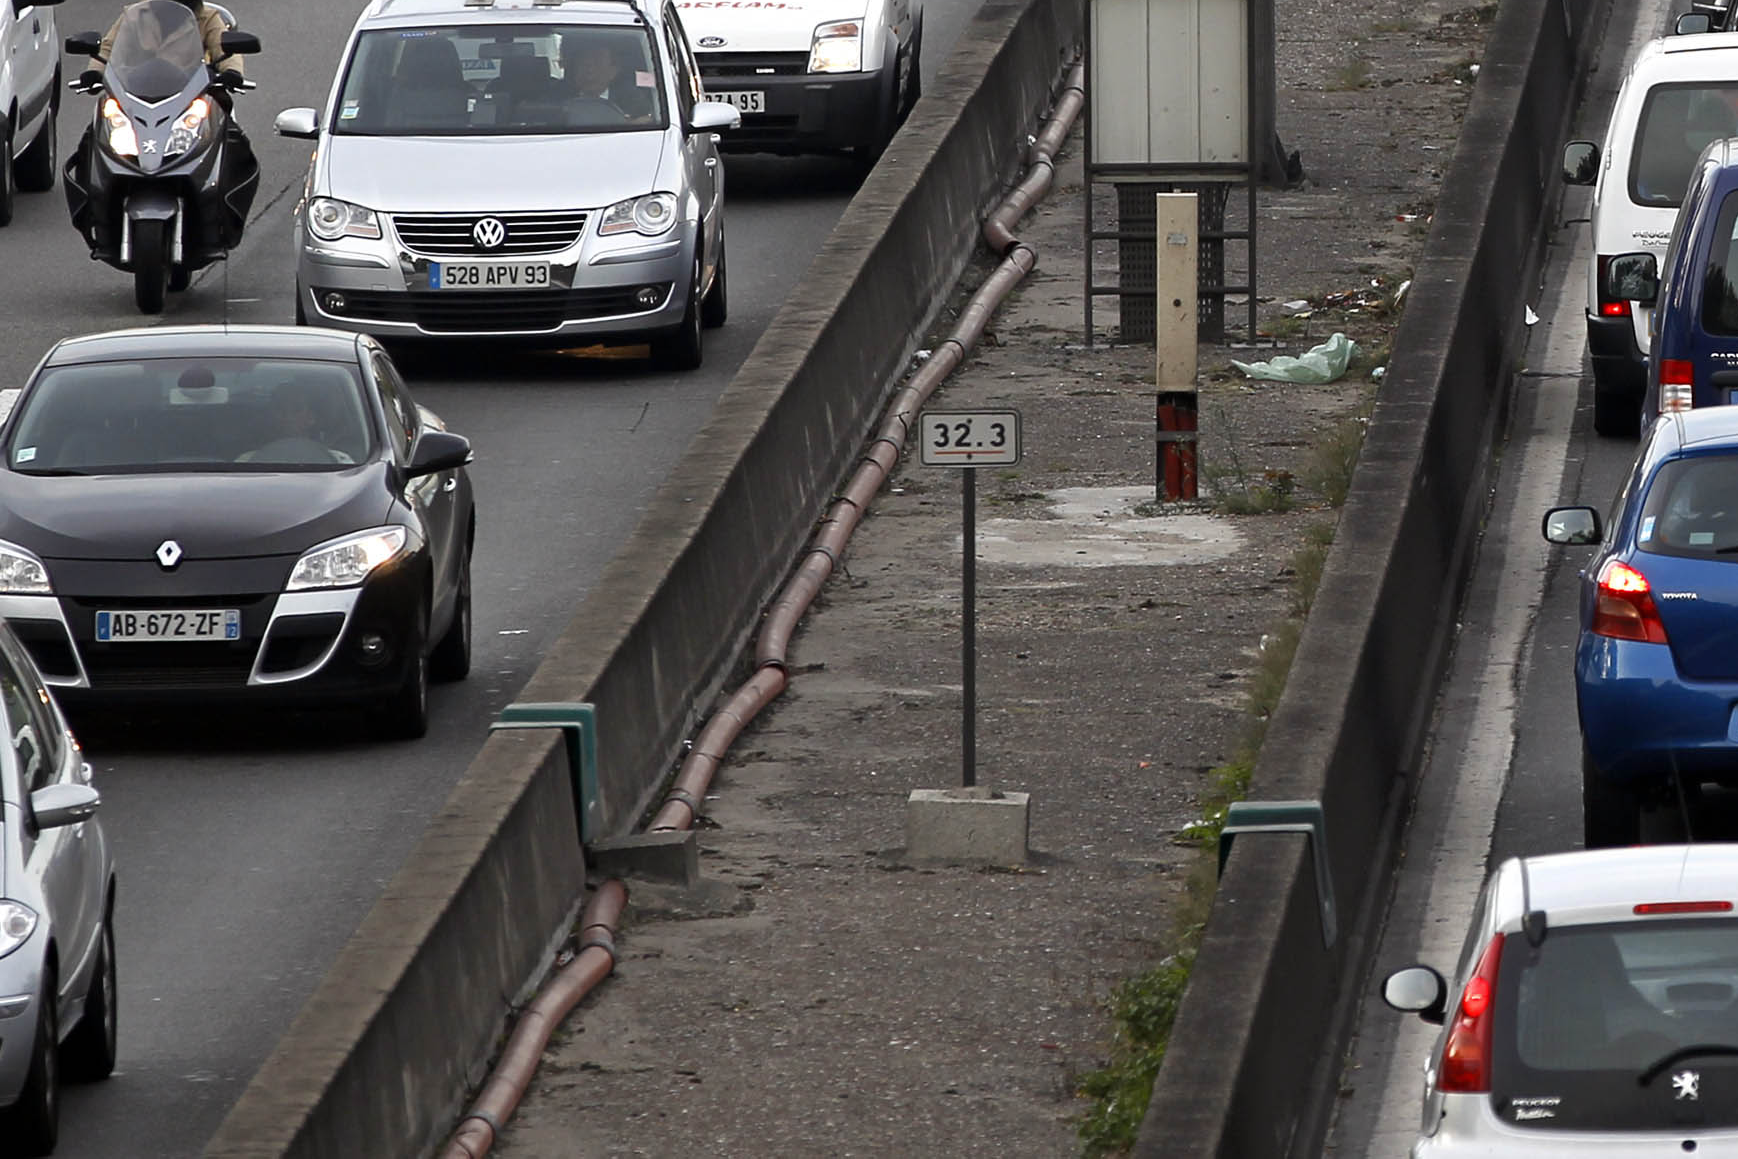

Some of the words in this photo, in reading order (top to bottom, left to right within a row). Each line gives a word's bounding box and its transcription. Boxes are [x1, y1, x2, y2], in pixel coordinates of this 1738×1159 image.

[740, 93, 760, 110] 95
[445, 268, 480, 286] 528
[486, 267, 519, 286] APV
[526, 266, 548, 284] 93
[934, 423, 1006, 448] 32.3
[1662, 592, 1698, 600] TOYOTA
[111, 613, 222, 638] AB-672-ZF
